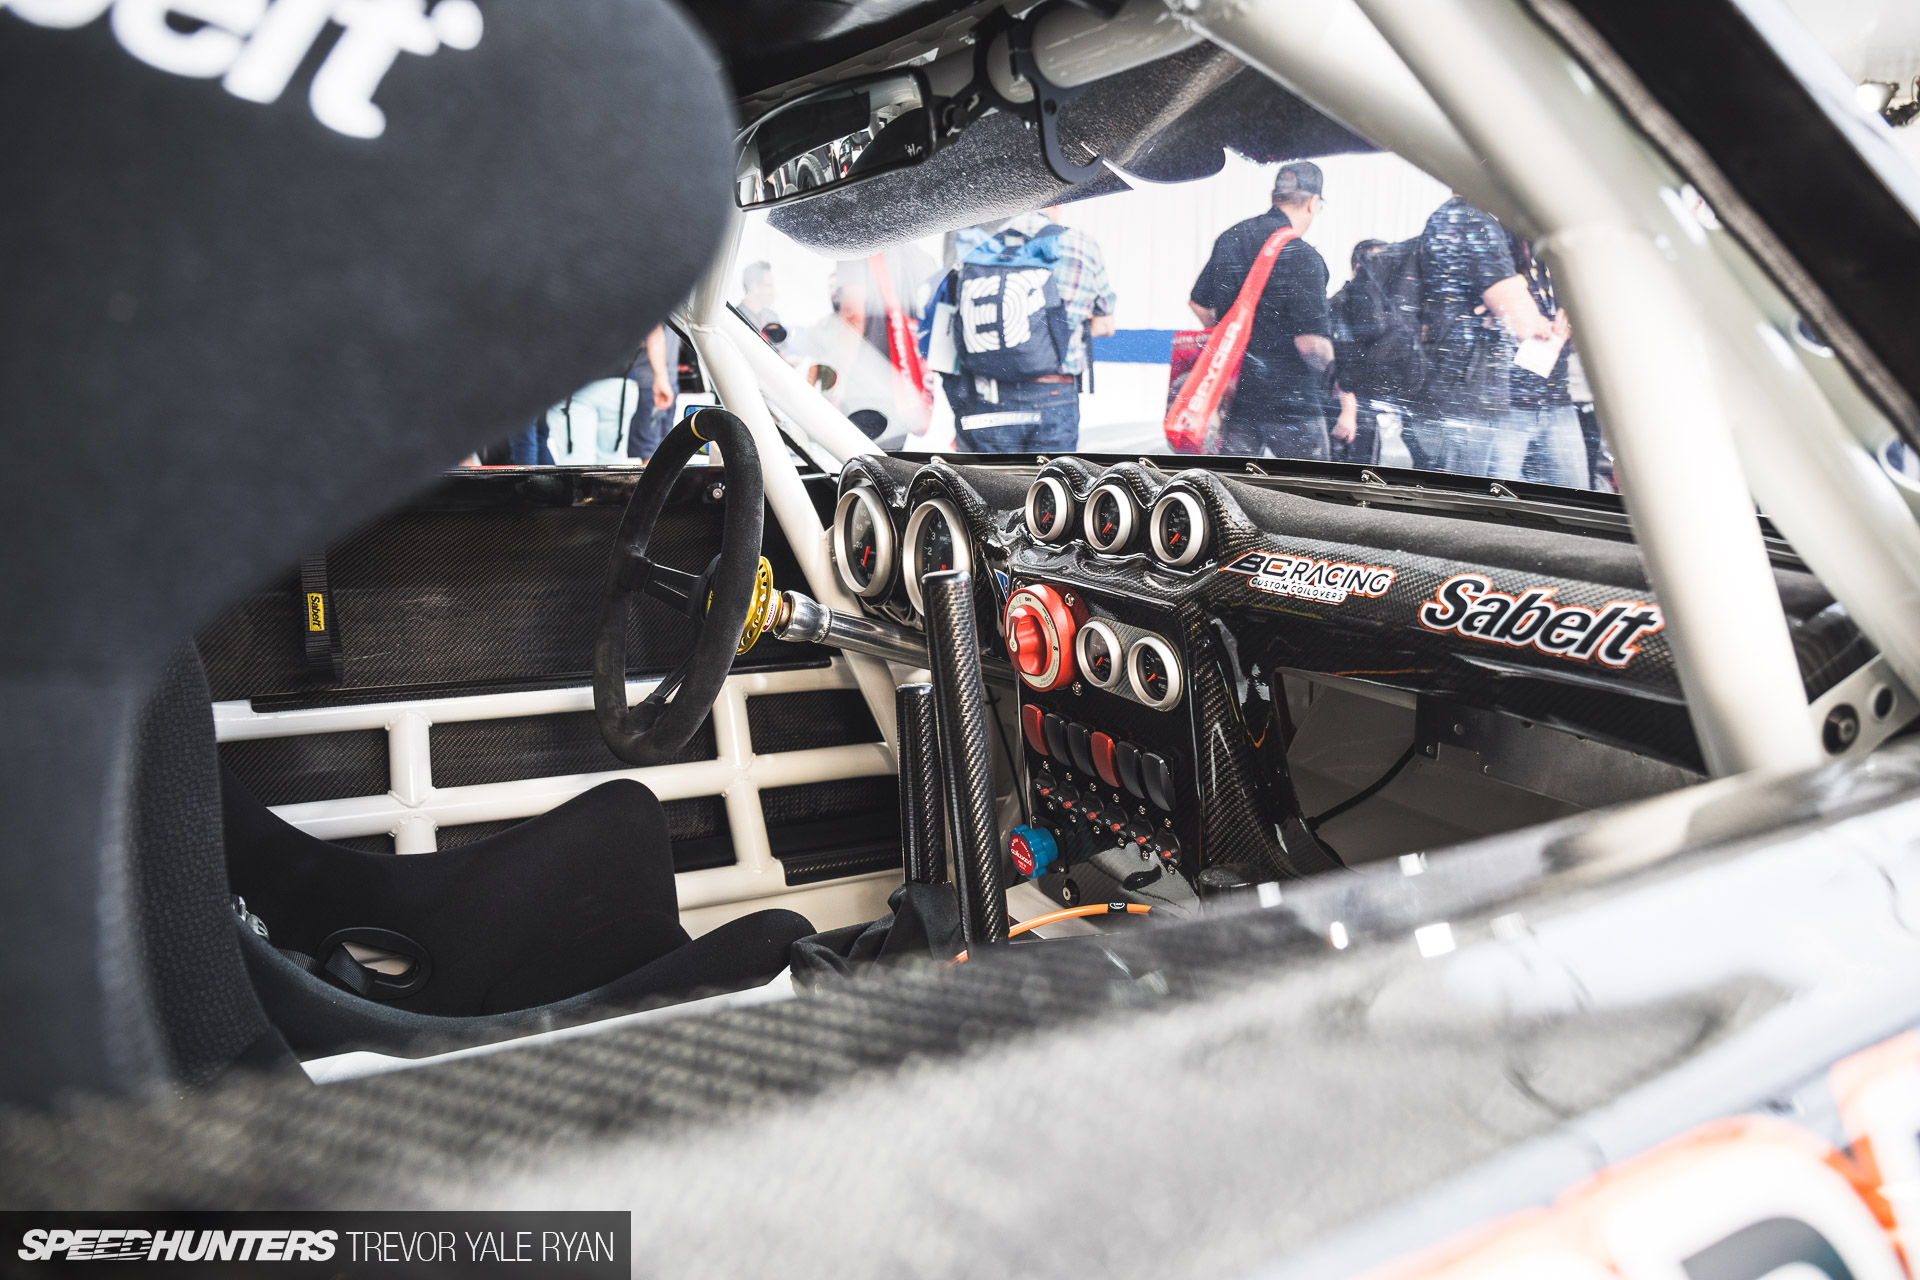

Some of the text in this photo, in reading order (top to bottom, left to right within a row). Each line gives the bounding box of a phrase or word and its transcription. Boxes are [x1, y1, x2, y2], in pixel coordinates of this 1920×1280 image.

[1187, 321, 1242, 413] SPYDER
[311, 595, 321, 627] Sabelt
[1251, 577, 1344, 601] CUSTOM COILOVERS
[1422, 576, 1658, 662] Sabelt
